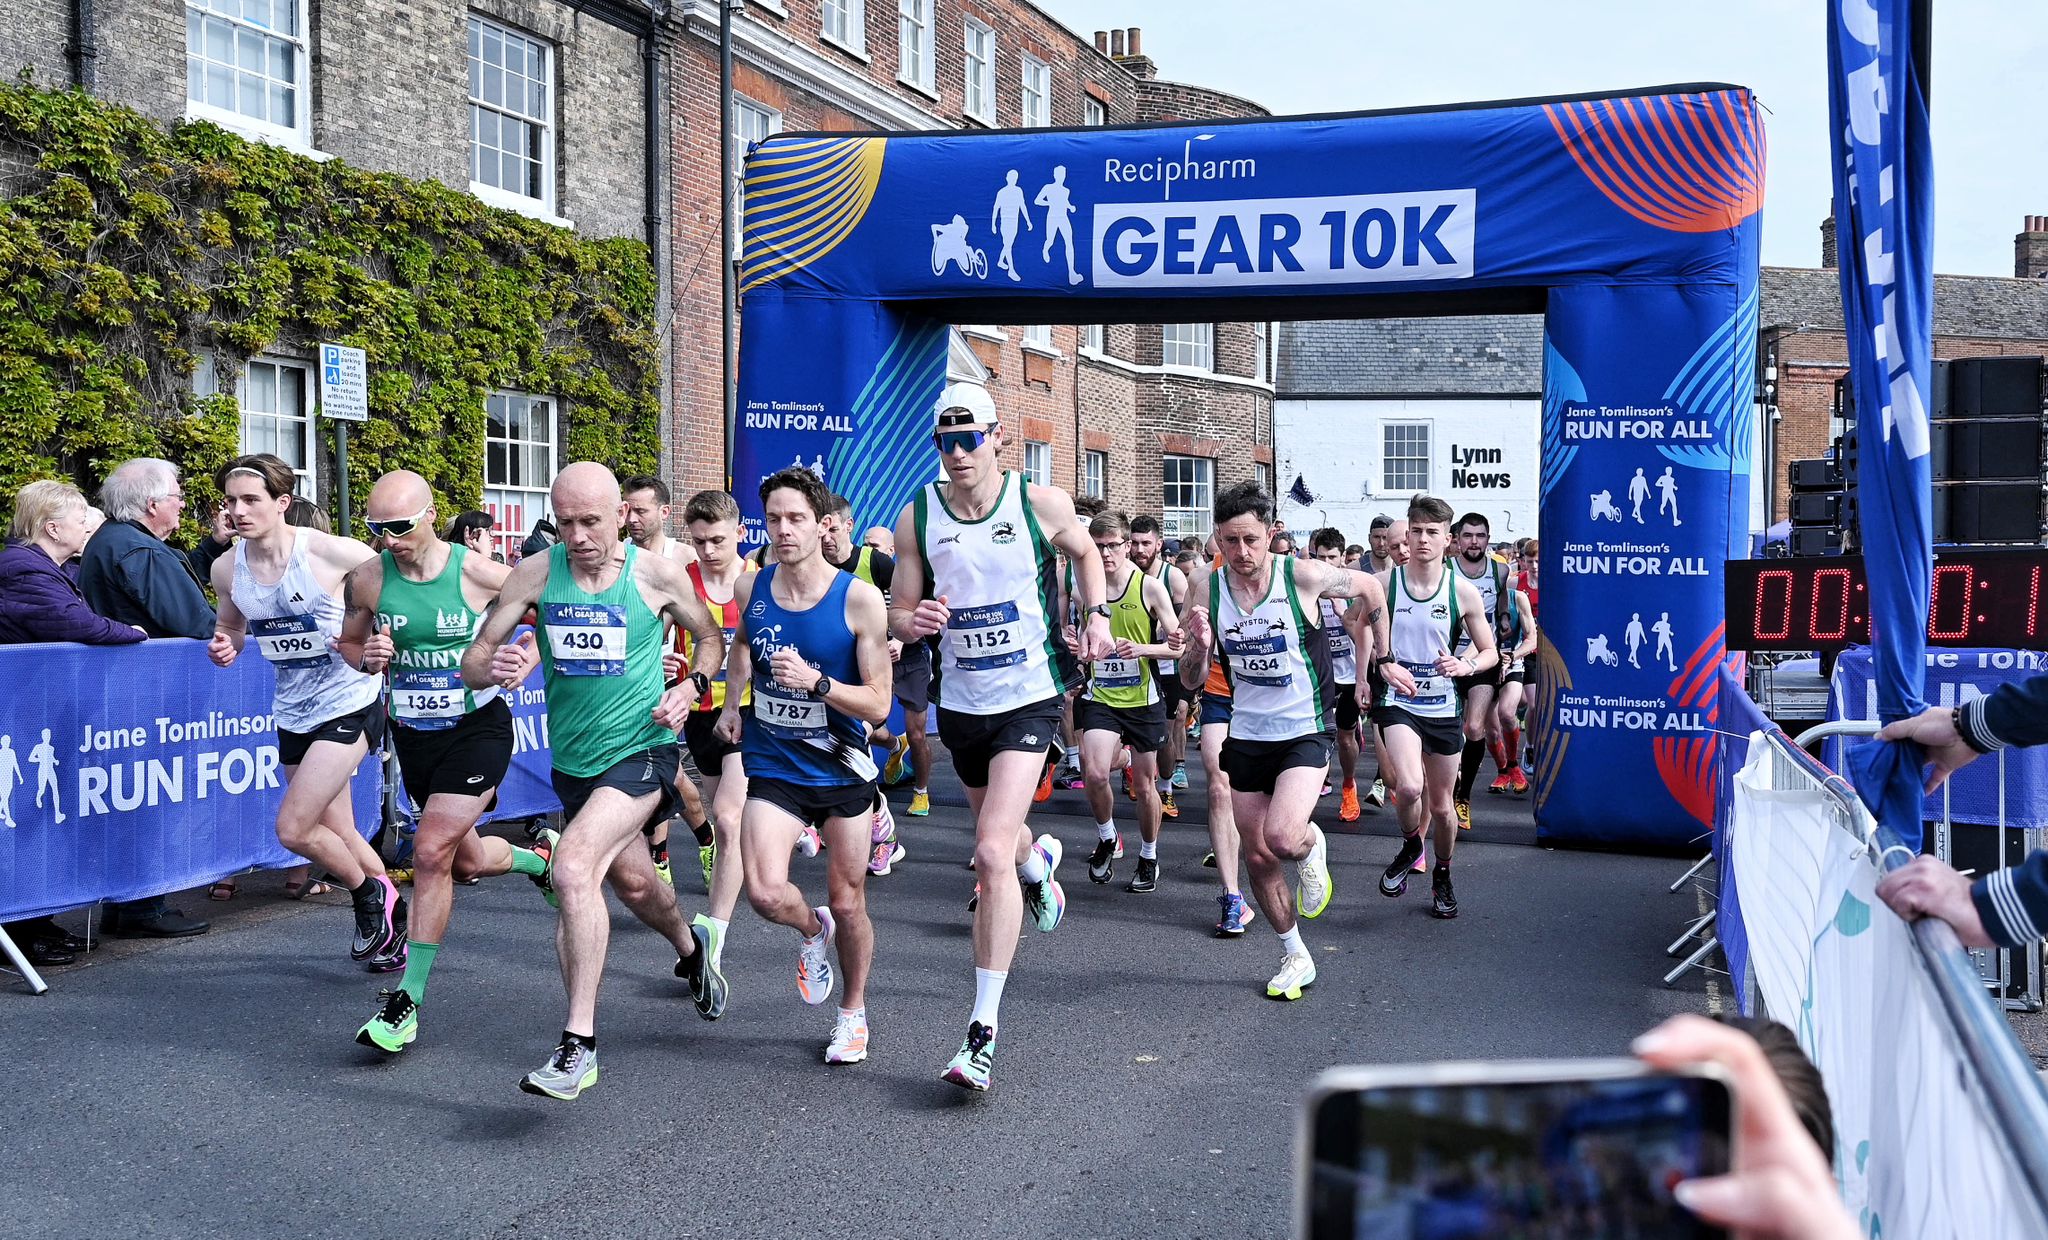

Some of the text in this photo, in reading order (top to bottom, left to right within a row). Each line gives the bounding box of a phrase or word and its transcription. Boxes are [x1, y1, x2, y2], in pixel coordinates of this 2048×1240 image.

[1104, 140, 1256, 200] Recipharm
[1102, 204, 1458, 277] GEAR 10K
[328, 349, 337, 364] P
[342, 371, 361, 379] loading
[747, 400, 824, 412] Jane Tomlinson's
[1566, 406, 1673, 417] Jane Tomlinson's
[745, 413, 853, 432] RUN FOR ALL
[1565, 420, 1713, 439] RUN FOR ALL
[1452, 444, 1501, 467] Lynn
[1452, 469, 1511, 488] News
[741, 516, 762, 526] Jane
[738, 529, 772, 545] RUN
[1563, 541, 1670, 553] Jane Tomlinson's
[1562, 556, 1709, 576] RUN FOR ALL
[1240, 618, 1269, 628] RYSTON
[271, 637, 312, 652] 1996
[562, 632, 603, 649] 430
[963, 629, 1011, 649] 1152
[1103, 662, 1125, 672] 781
[1241, 658, 1279, 671] 1634
[408, 695, 451, 710] 1365
[1560, 694, 1666, 709] Jane Tomlinson's
[767, 701, 811, 719] 1787
[1559, 708, 1705, 731] RUN FOR ALL
[79, 724, 147, 753] Jane
[79, 745, 280, 817] RUN FOR
